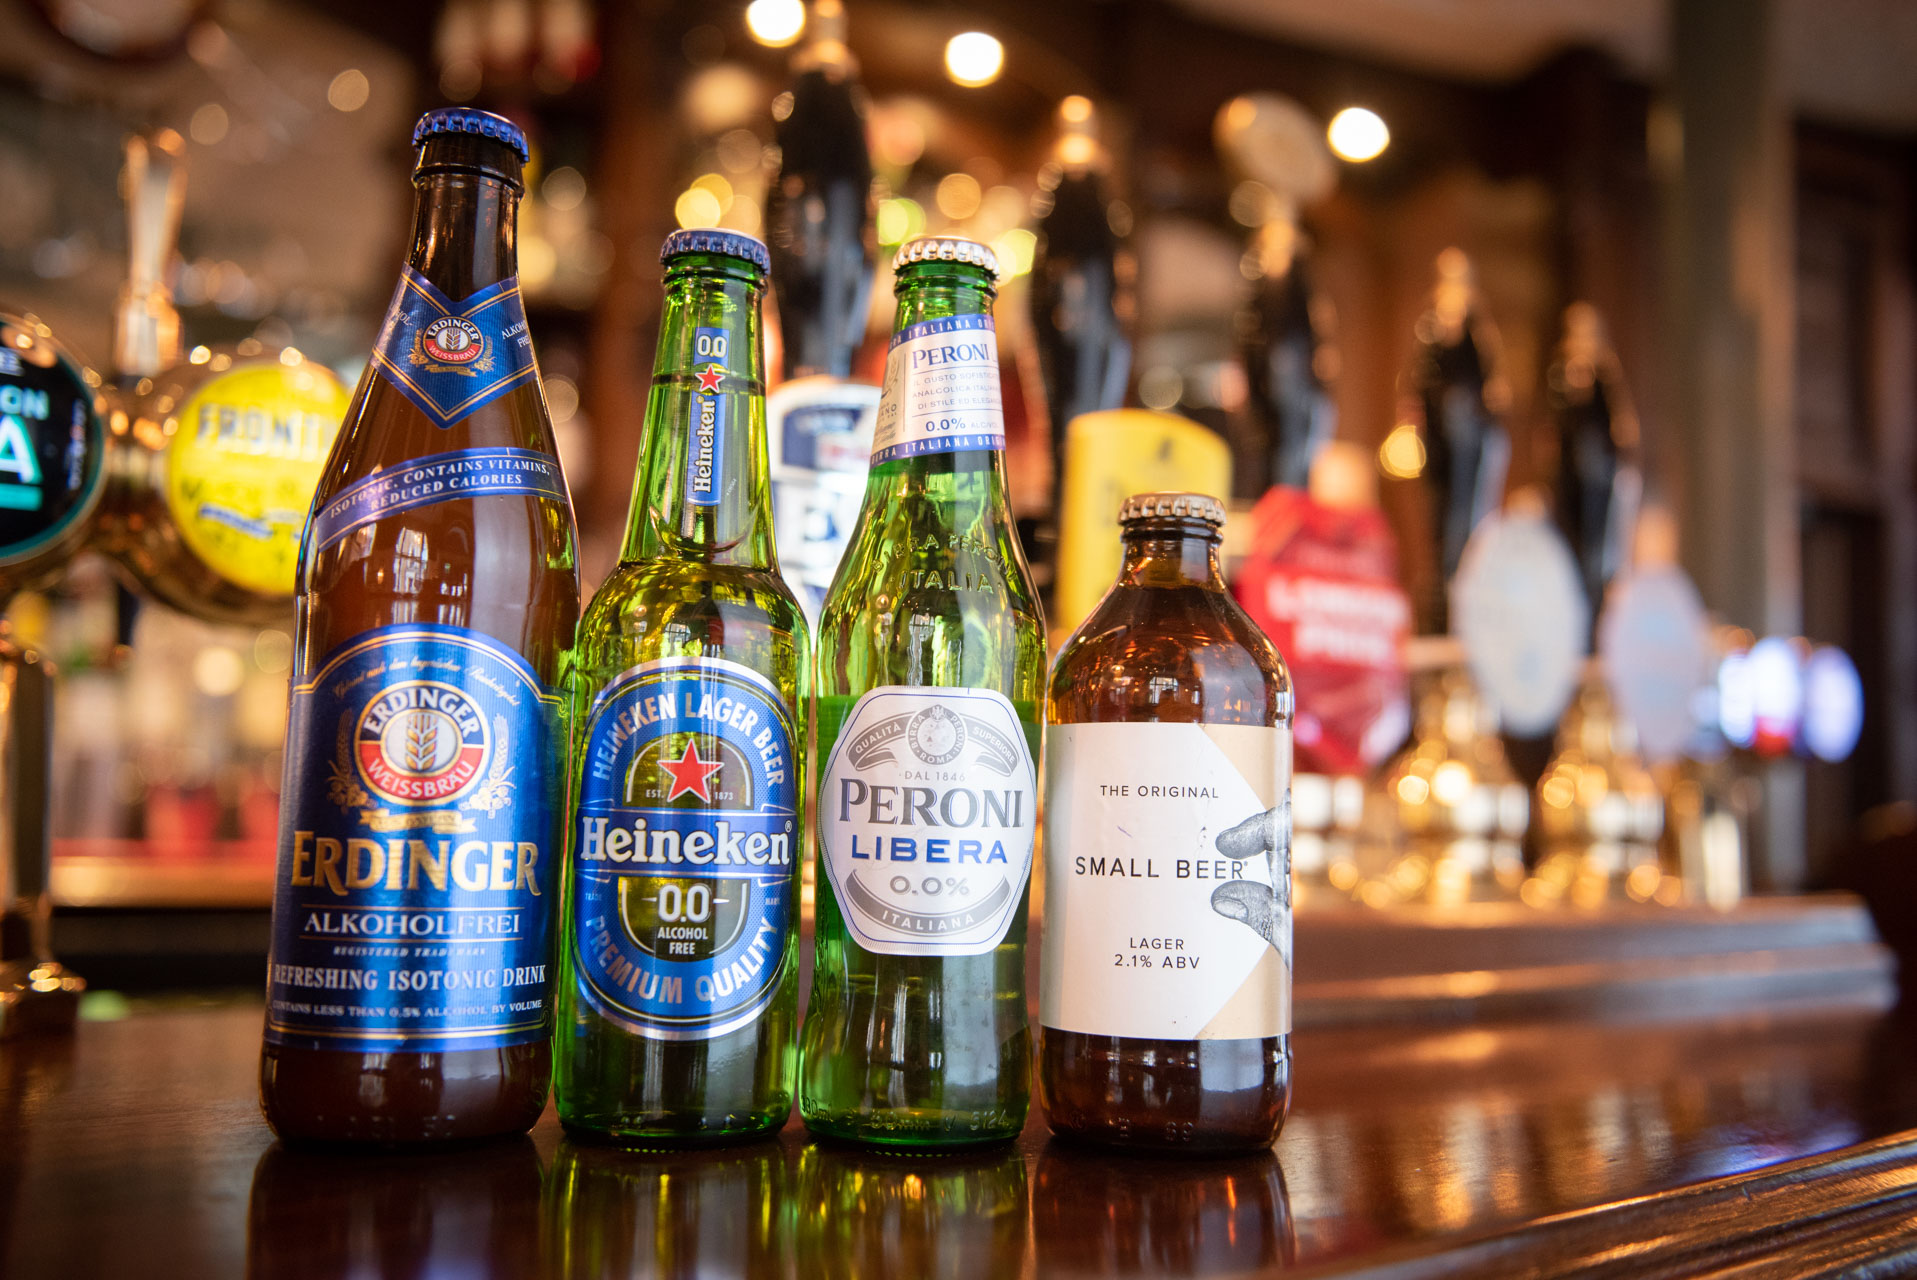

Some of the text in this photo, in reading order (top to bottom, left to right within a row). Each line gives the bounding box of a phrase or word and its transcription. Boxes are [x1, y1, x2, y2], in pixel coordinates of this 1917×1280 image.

[428, 319, 480, 341] ERDINGER
[908, 319, 971, 339] ITALIANA
[696, 335, 728, 358] 0.0
[912, 343, 990, 369] PERONI
[924, 374, 957, 384] GUSTO
[913, 385, 970, 398] ANALCOLICA
[930, 399, 955, 408] STILE
[926, 418, 966, 432] 0.0%
[693, 400, 716, 494] Heineken
[904, 435, 970, 453] ITALIANA
[403, 459, 483, 485] CONTAINS
[489, 459, 551, 475] VITAMINS,
[370, 474, 522, 511] REDUCED CALORIES
[899, 569, 994, 594] ITALIA
[363, 687, 481, 738] ERDINGER
[592, 692, 784, 787] HEINEKEN LAGER BEER
[855, 721, 1015, 763] QUALITÀ SUPERIORE
[910, 714, 966, 753] BIRRA PERONI
[920, 752, 953, 764] ROMA
[904, 770, 966, 782] DAL 1846
[646, 789, 734, 801] EST. 1873
[839, 778, 1024, 828] PERONI
[1100, 785, 1219, 799] THE ORIGINAL
[851, 834, 1008, 864] LIBERA
[291, 830, 542, 896] ERDINGER
[1075, 856, 1243, 879] SMALL BEER
[889, 875, 970, 897] 0.0%
[658, 883, 711, 923] 0.0
[882, 910, 975, 931] ITALIANA
[657, 926, 708, 940] ALCOHOL
[1130, 937, 1184, 950] LAGER
[334, 945, 409, 958] REGISTERED
[585, 915, 778, 1004] PREMIUM QUALITY
[668, 942, 696, 955] FREE
[1114, 953, 1200, 969] 2.1% ABV
[274, 964, 546, 991] REFRESHING ISOTONIC DRINK
[314, 1004, 345, 1017] LESS
[348, 1006, 386, 1018] THAN
[491, 1004, 507, 1015] BY
[509, 999, 542, 1012] VOLUME
